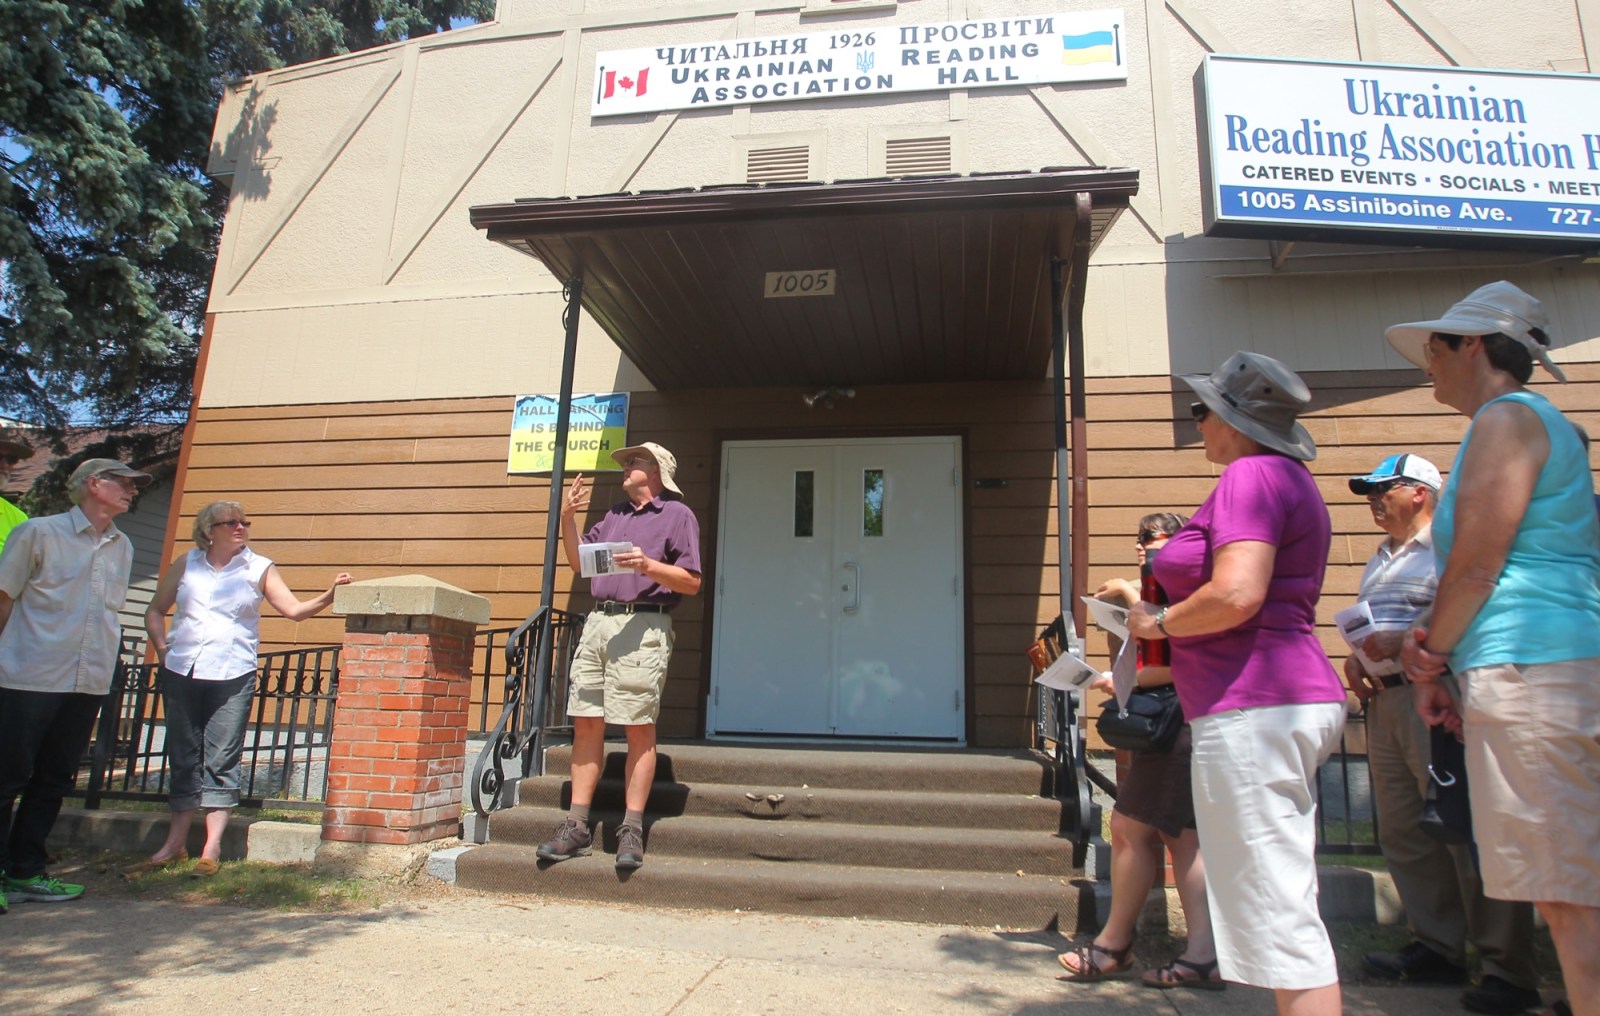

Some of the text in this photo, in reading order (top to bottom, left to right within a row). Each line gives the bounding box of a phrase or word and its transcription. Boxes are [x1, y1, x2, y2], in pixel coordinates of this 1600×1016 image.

[656, 17, 1055, 65] ЧИТАЛЬНЯ 1926 ПРОСВІТИ
[671, 43, 1039, 84] UKRAINIAN READING
[691, 66, 1019, 103] ASSOCIATION HALL
[1343, 78, 1527, 124] Ukrainian
[1224, 114, 1370, 167] Reading
[1378, 123, 1575, 169] Association
[1242, 165, 1334, 182] CATERED
[1340, 169, 1417, 187] EVENTS
[1439, 175, 1526, 192] SOCIALS
[1237, 191, 1296, 210] 1005
[1303, 194, 1451, 217] Assiniboine
[1458, 202, 1513, 221] Ave.
[773, 272, 829, 293] 1005
[520, 404, 624, 416] HALL ARKING
[531, 421, 605, 434] IS BHIND
[515, 440, 610, 453] THE CURCH
